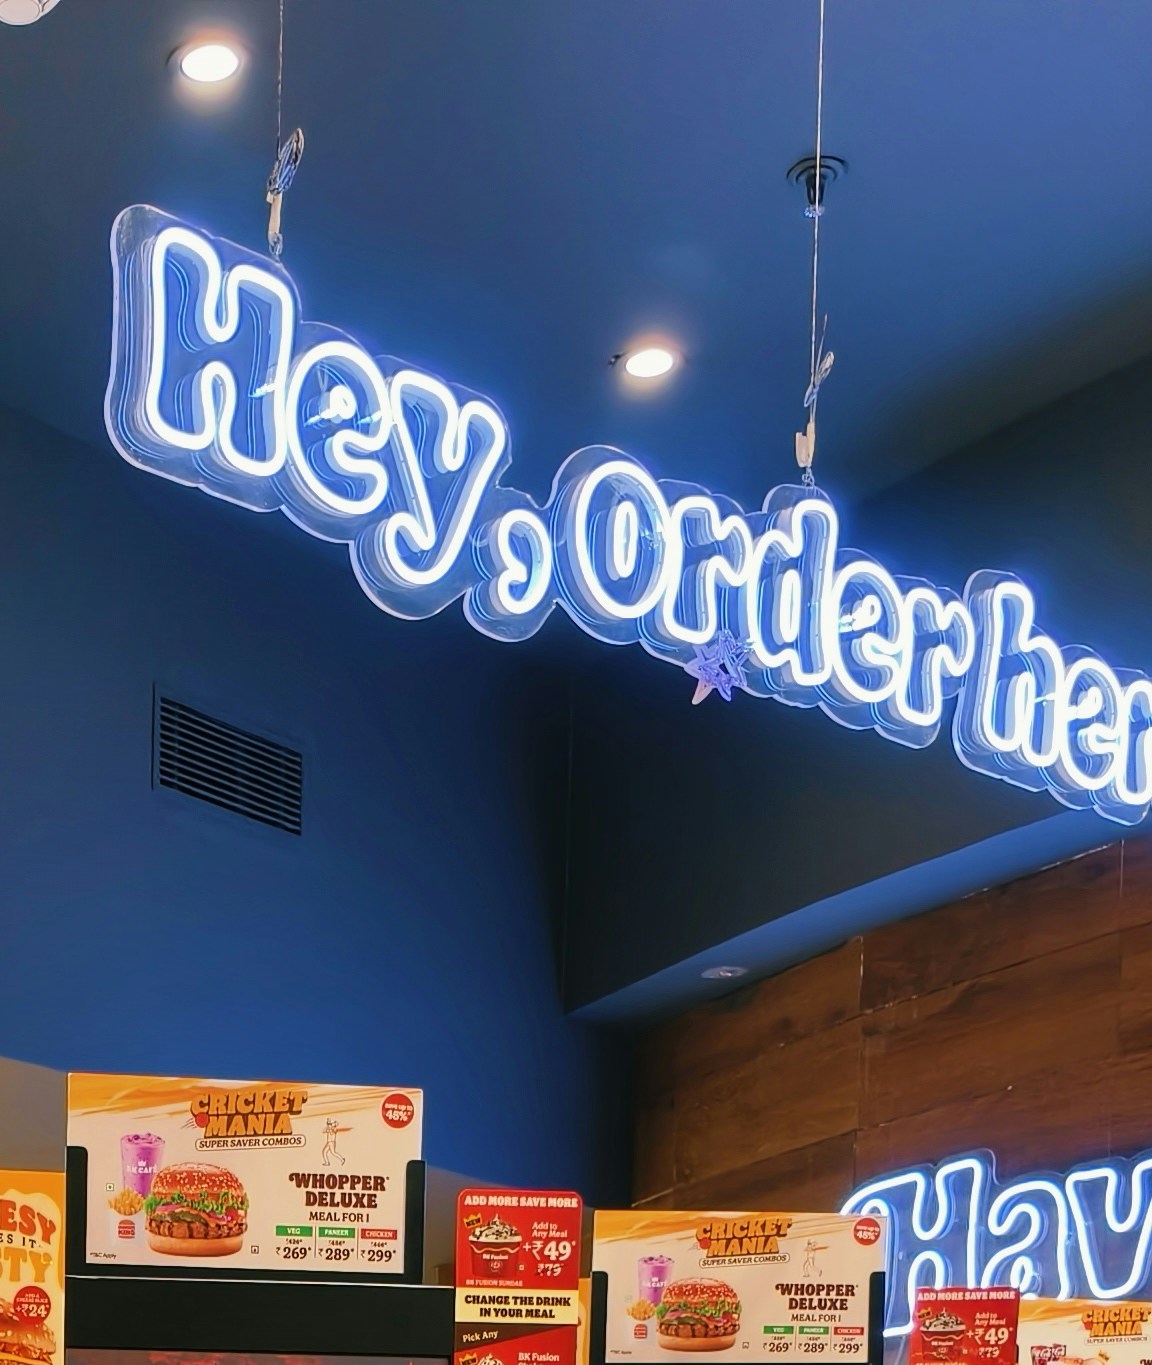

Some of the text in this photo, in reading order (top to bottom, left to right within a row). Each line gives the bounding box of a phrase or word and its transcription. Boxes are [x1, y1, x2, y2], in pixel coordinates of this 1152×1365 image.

[146, 225, 552, 615] Hey,
[575, 459, 974, 727] Order
[190, 1091, 308, 1116] CRICKET
[203, 1113, 293, 1138] MANIA
[199, 1137, 302, 1149] SUPER SAVER COMBOS
[304, 1191, 378, 1209] DELUXE
[464, 1195, 578, 1208] ADD MORE SAVE MORE
[696, 1218, 793, 1240] CRICKET
[22, 1237, 37, 1249] IT
[706, 1236, 780, 1258] MANIA
[465, 1294, 571, 1307] CHANGE THE DRINK
[788, 1297, 849, 1311] DELUXE
[479, 1307, 556, 1319] IN YOUR MEAL
